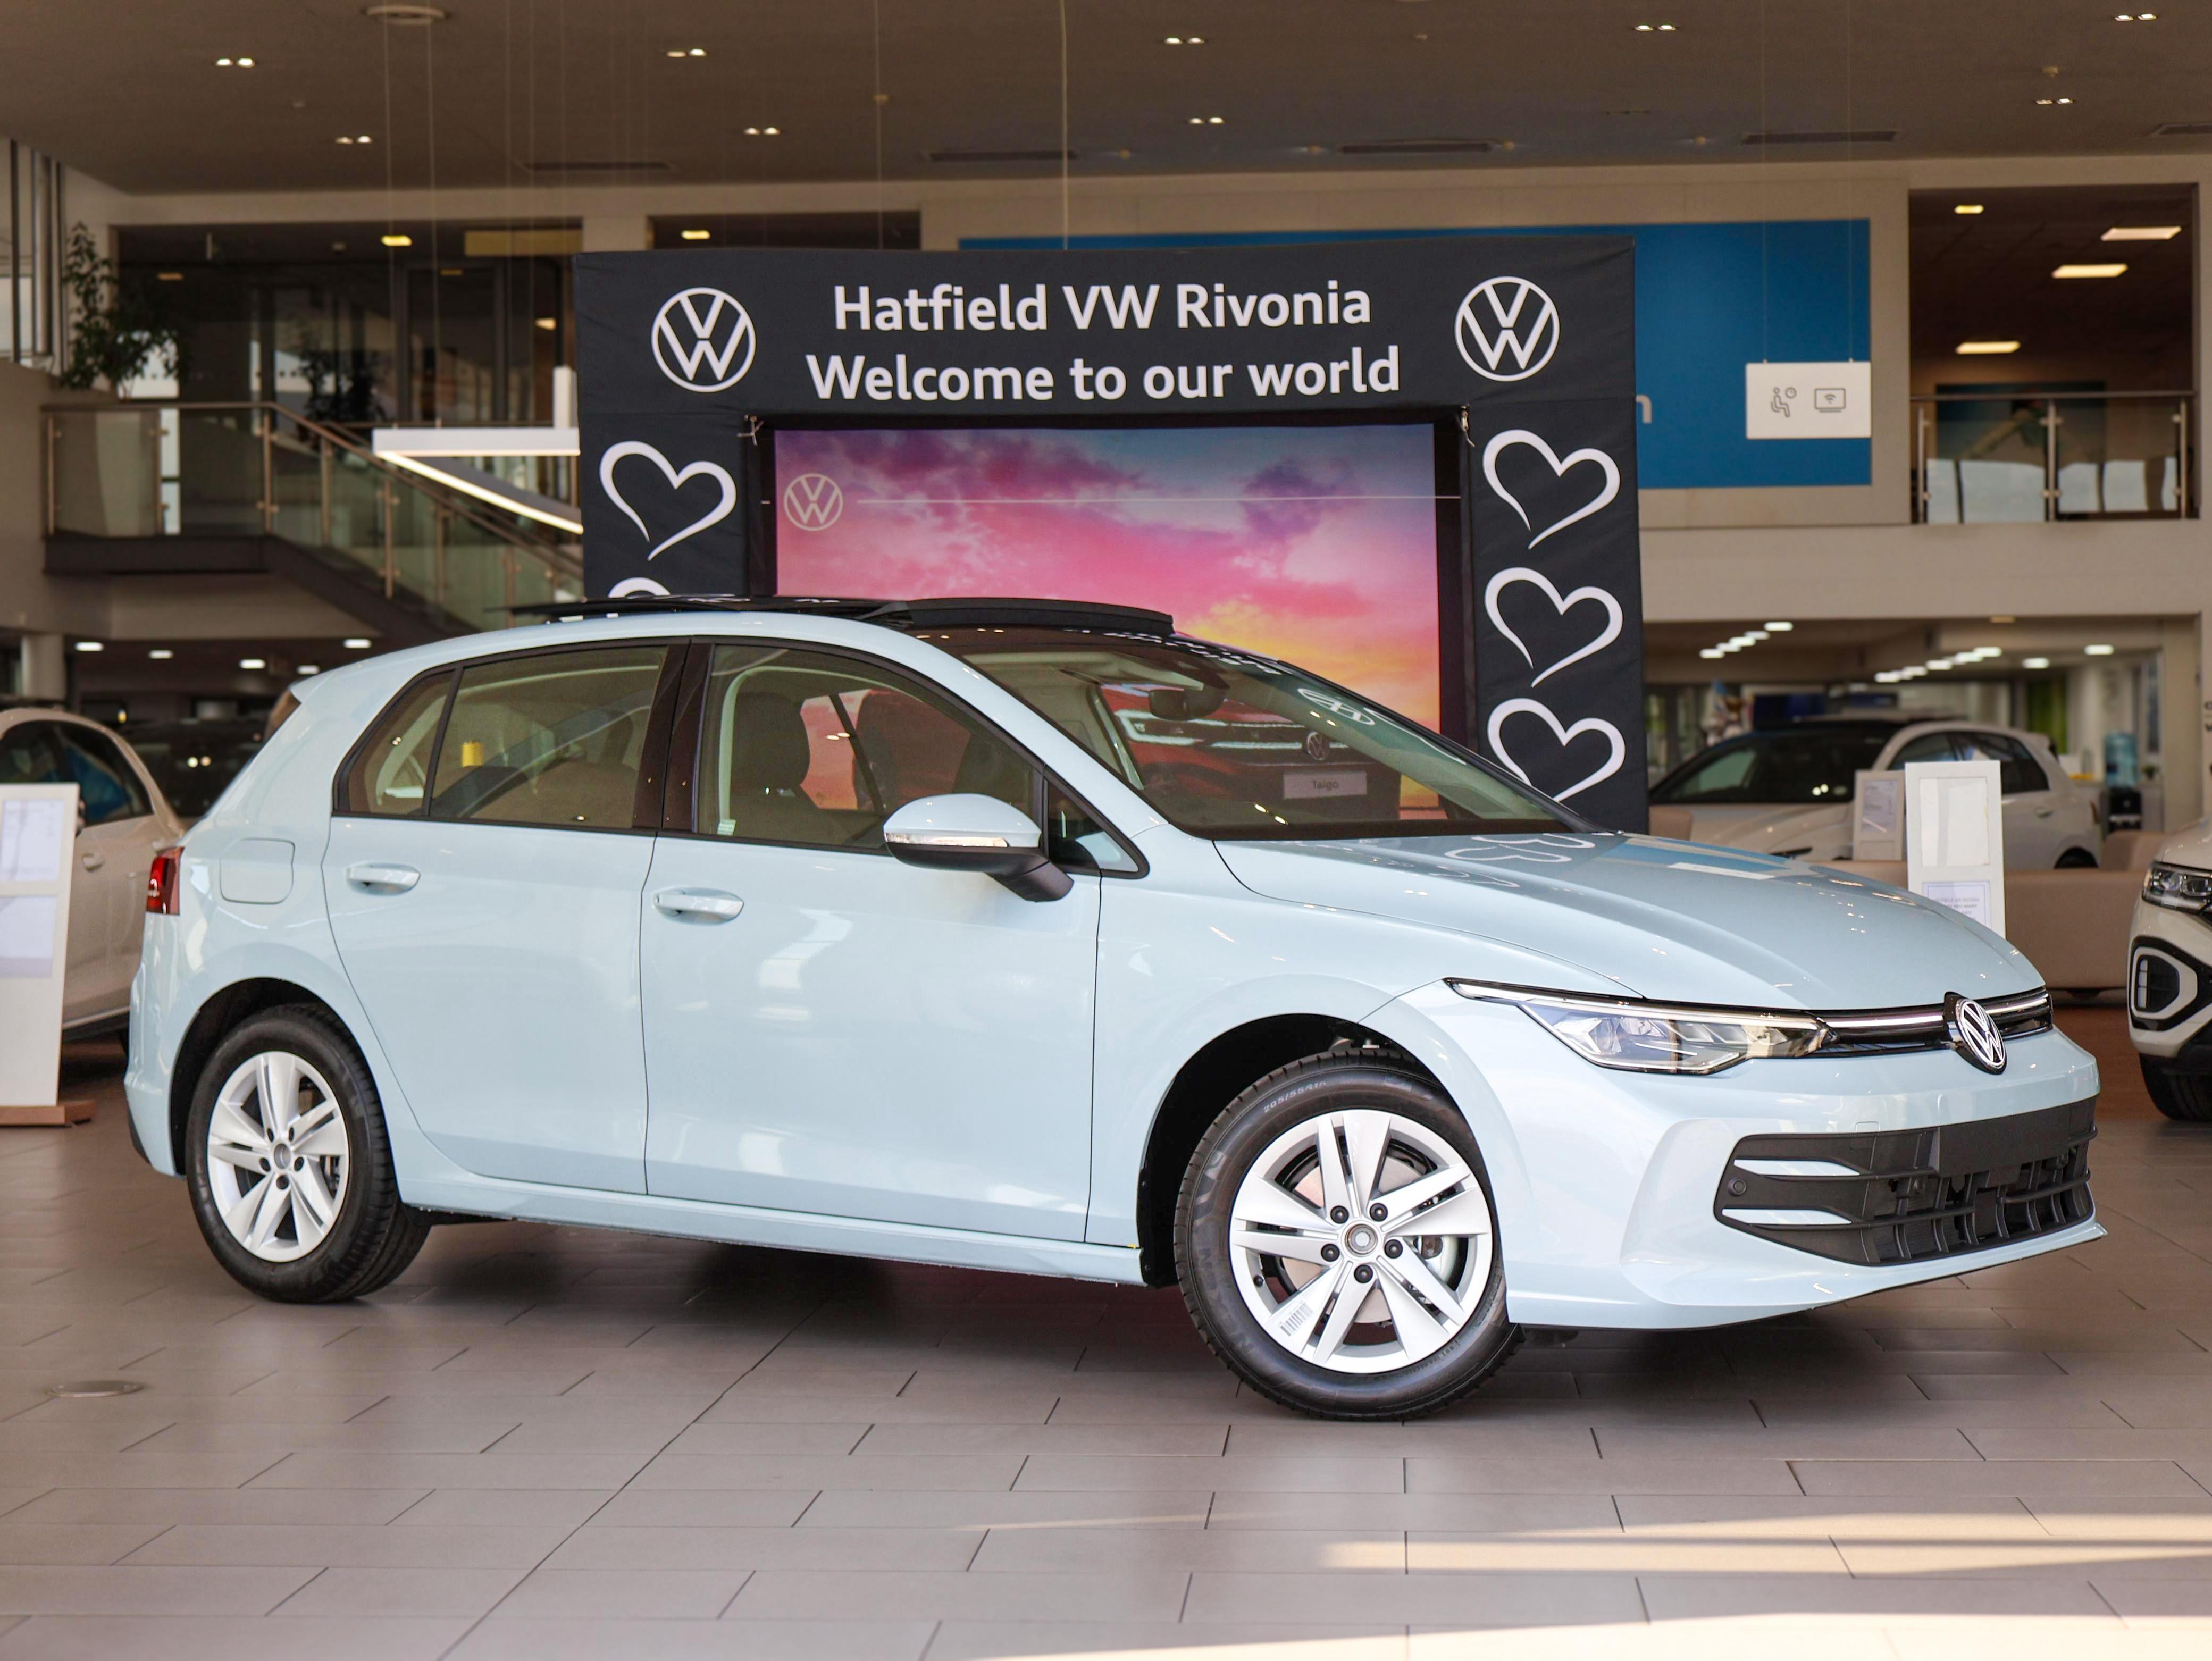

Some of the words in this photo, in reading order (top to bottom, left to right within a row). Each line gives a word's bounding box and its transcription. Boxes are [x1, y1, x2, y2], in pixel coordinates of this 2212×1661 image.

[834, 283, 1047, 331] Hatfield
[1062, 284, 1160, 330] VW
[1177, 280, 1370, 328] Rivonia
[1455, 276, 1560, 382] VW
[651, 287, 756, 392] VW
[806, 354, 1054, 401] Welcome
[1069, 358, 1127, 400] to
[1143, 364, 1233, 399] our
[1247, 345, 1399, 396] world
[1311, 779, 1339, 792] Taigo
